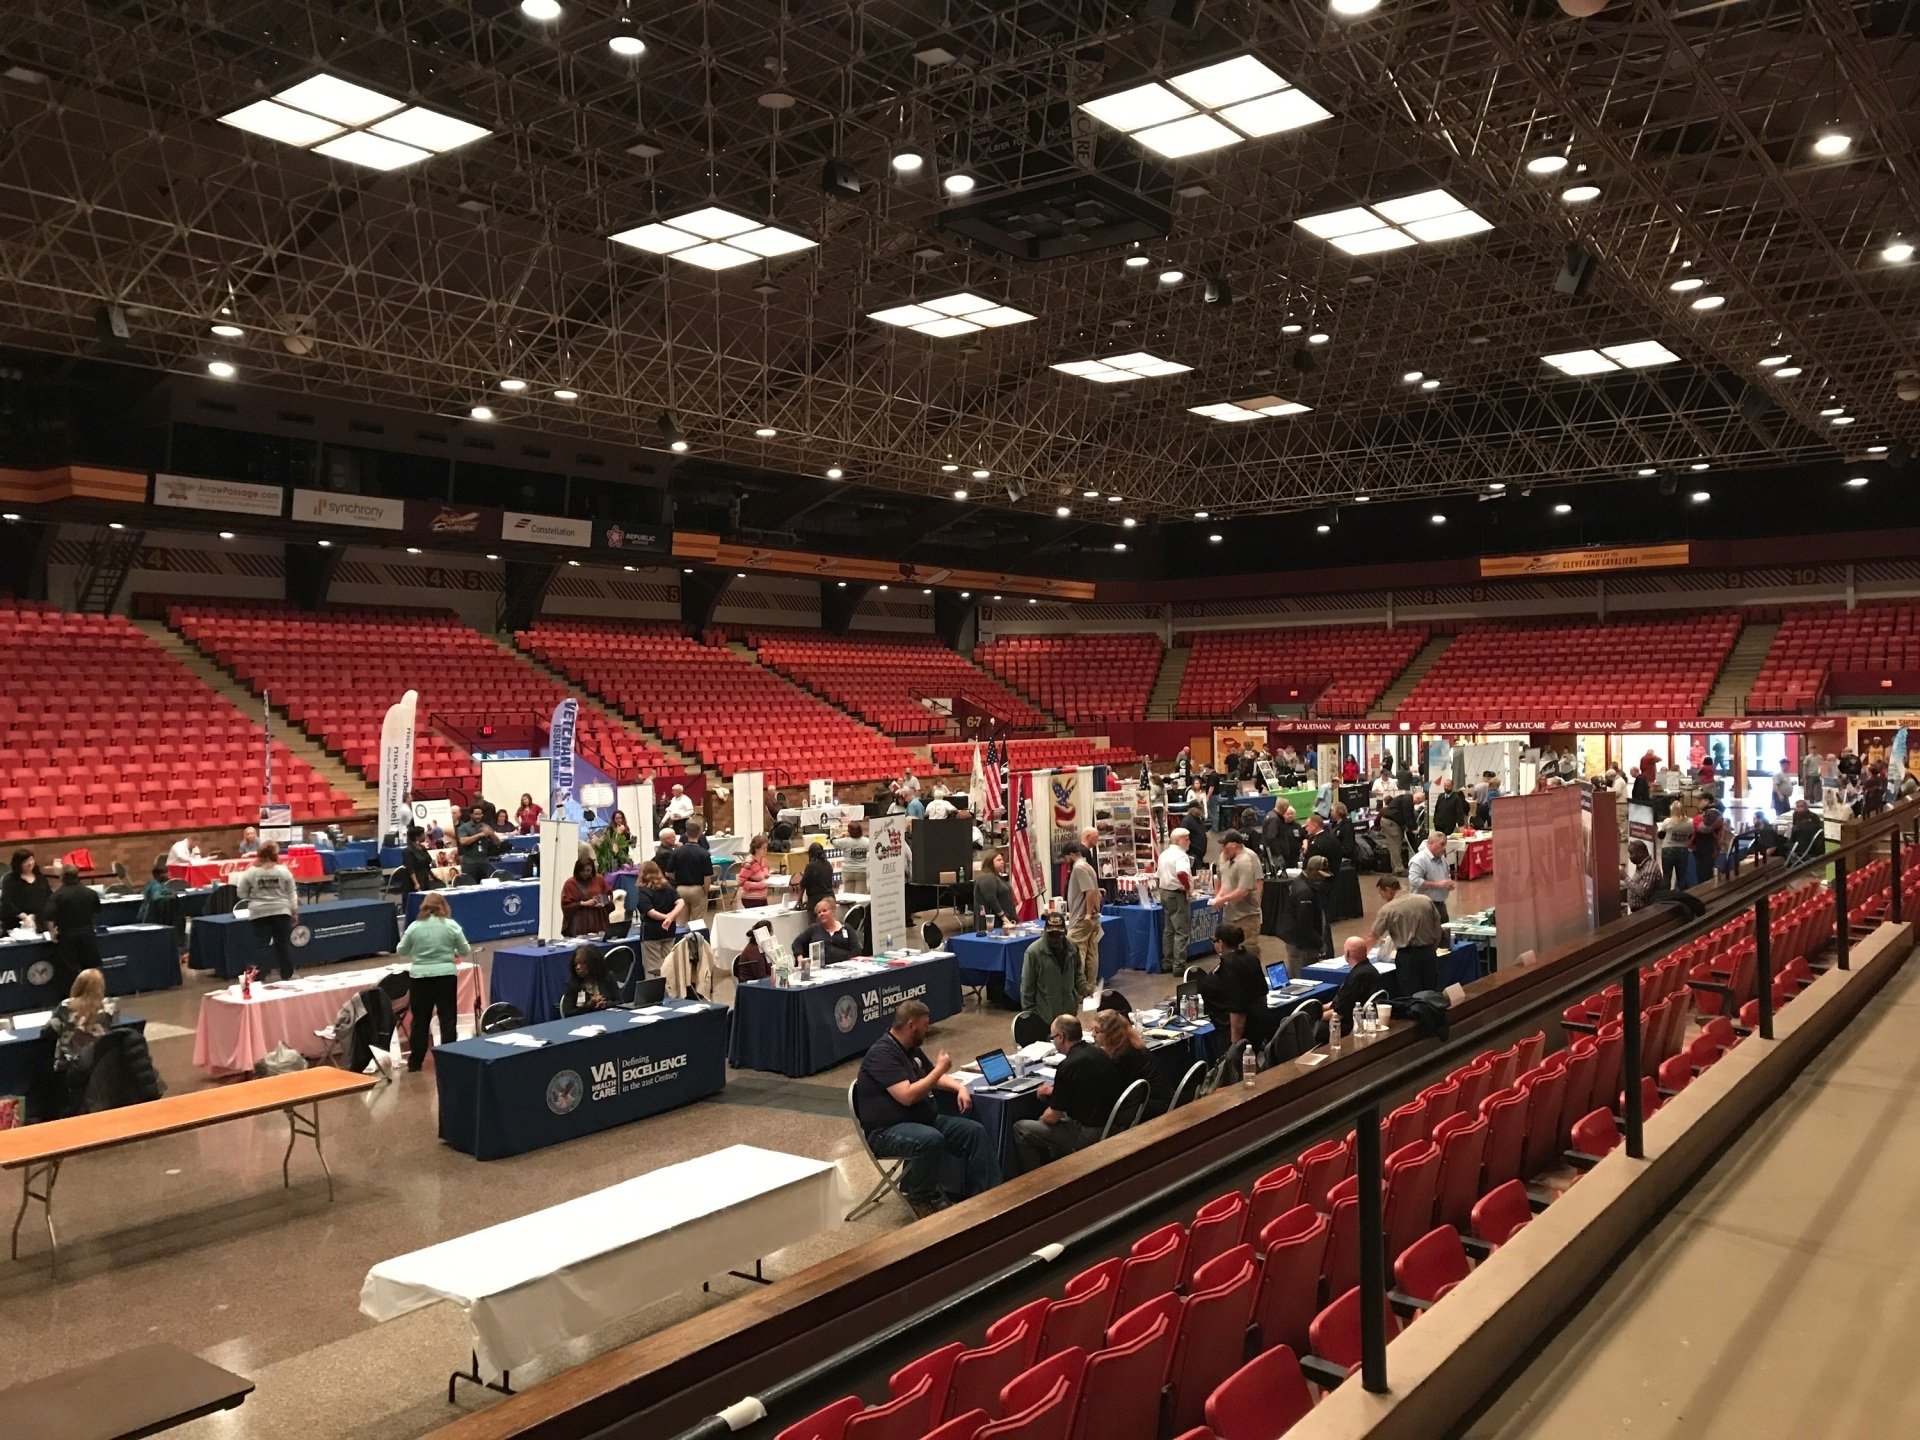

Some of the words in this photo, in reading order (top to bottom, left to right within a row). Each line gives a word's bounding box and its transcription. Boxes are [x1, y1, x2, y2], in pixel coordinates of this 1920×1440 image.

[329, 502, 384, 518] synchrony
[531, 524, 575, 537] Constellation
[626, 532, 656, 542] REPUBLIC
[1562, 558, 1600, 569] CLEVELAND
[1602, 556, 1638, 567] CAVALIERS
[429, 569, 443, 584] 4
[466, 572, 479, 588] 5
[1727, 573, 1742, 588] 9
[1793, 568, 1817, 585] 10
[669, 587, 680, 601] 5
[1423, 592, 1434, 604] 8
[1472, 588, 1484, 601] 9
[984, 607, 992, 620] 7
[553, 724, 561, 757] ISSUED
[560, 702, 577, 768] VETERAN
[552, 760, 560, 783] HERE
[390, 774, 400, 826] Campbell
[0, 970, 17, 985] VA
[862, 990, 880, 1007] VA
[882, 984, 927, 1007] EXCELLENCE
[863, 1005, 880, 1015] HEALTH
[863, 1010, 880, 1022] CARE
[622, 1055, 650, 1069] Defining
[622, 1054, 688, 1083] EXCELLENCE
[590, 1061, 617, 1083] VA
[592, 1079, 617, 1092] HEALTH
[622, 1083, 629, 1093] in
[630, 1080, 641, 1091] the
[641, 1077, 654, 1088] 21st
[654, 1070, 679, 1084] Century
[592, 1086, 617, 1101] CARE
